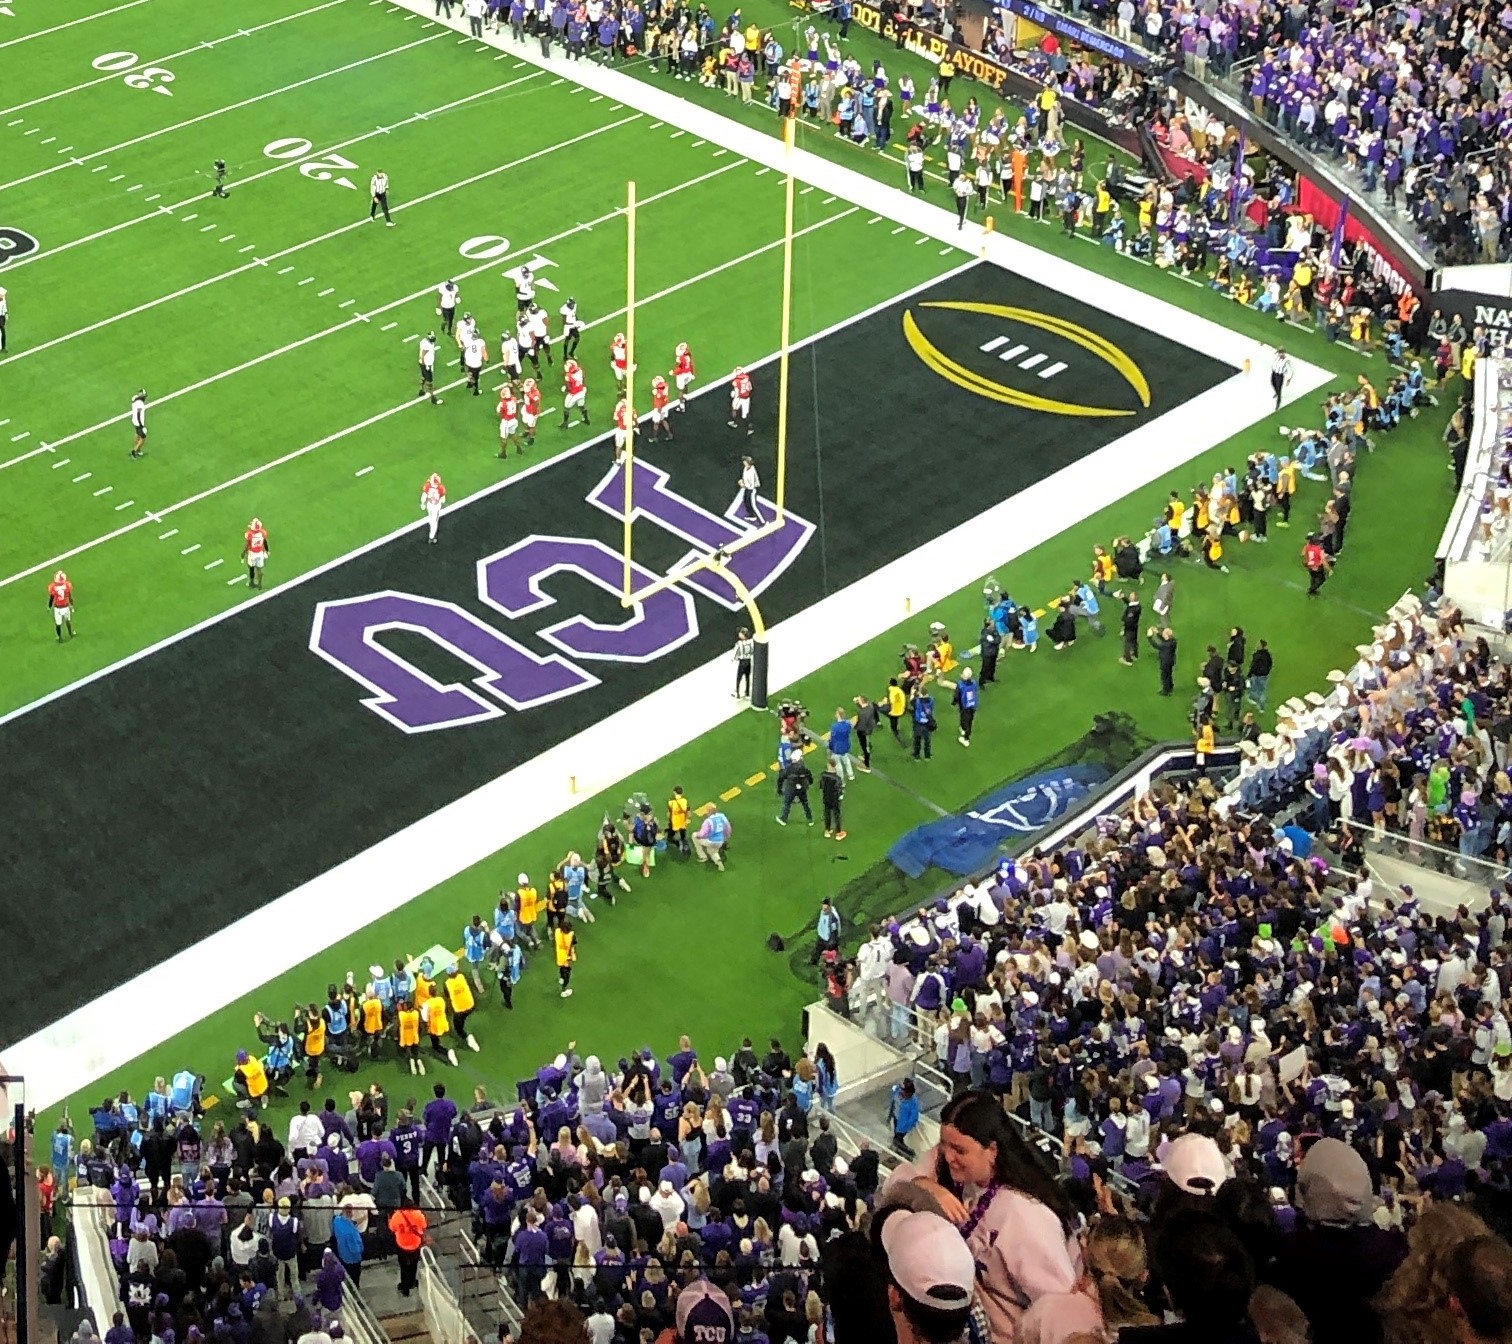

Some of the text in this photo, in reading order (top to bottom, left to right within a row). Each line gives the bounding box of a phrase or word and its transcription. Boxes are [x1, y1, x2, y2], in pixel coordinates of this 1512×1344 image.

[91, 51, 177, 89] 30
[930, 38, 1007, 89] PLAYOFF
[263, 137, 359, 181] 20
[309, 456, 817, 734] TCU
[694, 1325, 727, 1343] TCU
